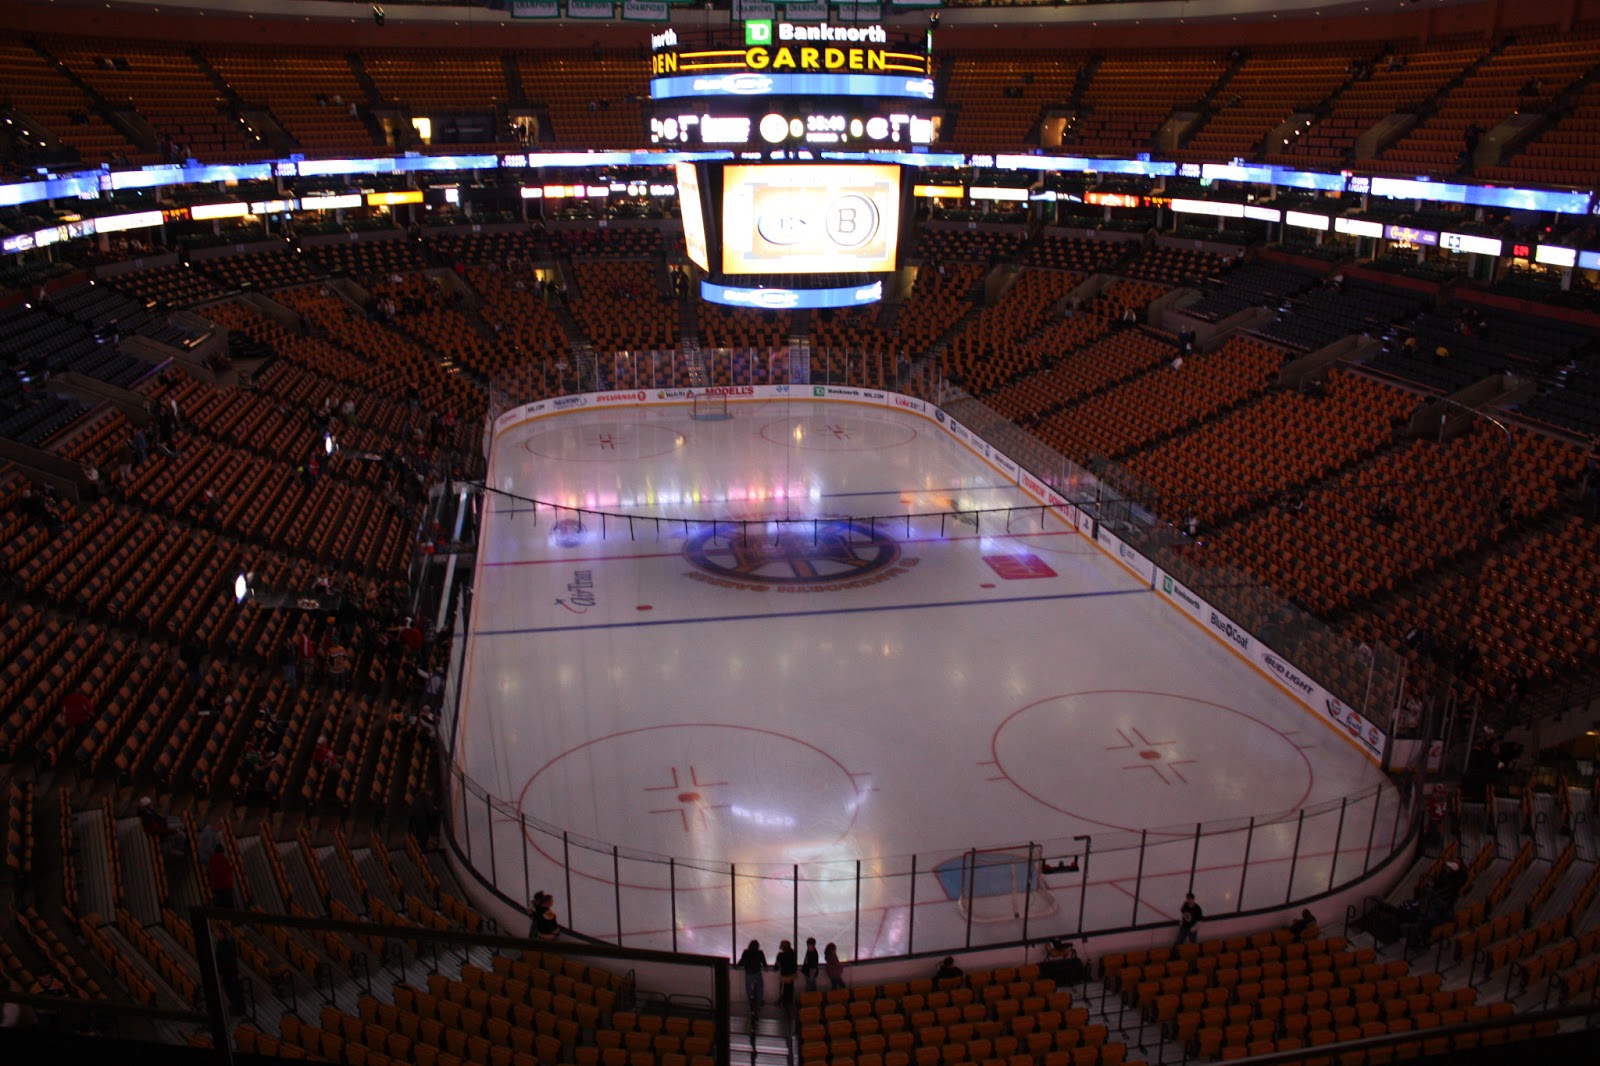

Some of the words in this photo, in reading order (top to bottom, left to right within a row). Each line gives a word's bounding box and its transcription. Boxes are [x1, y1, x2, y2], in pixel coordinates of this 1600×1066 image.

[626, 3, 665, 12] CHAMPIONS
[778, 23, 887, 43] Banknorth
[745, 47, 887, 70] GARDEN
[837, 207, 857, 234] B
[596, 393, 637, 402] SYLVANIA
[864, 392, 884, 400] NHL.COM
[1174, 585, 1201, 610] Banknorth
[1210, 612, 1226, 633] Blue
[1231, 628, 1248, 650] Coat
[1264, 655, 1285, 675] BUD
[1285, 670, 1314, 694] LIGHT
